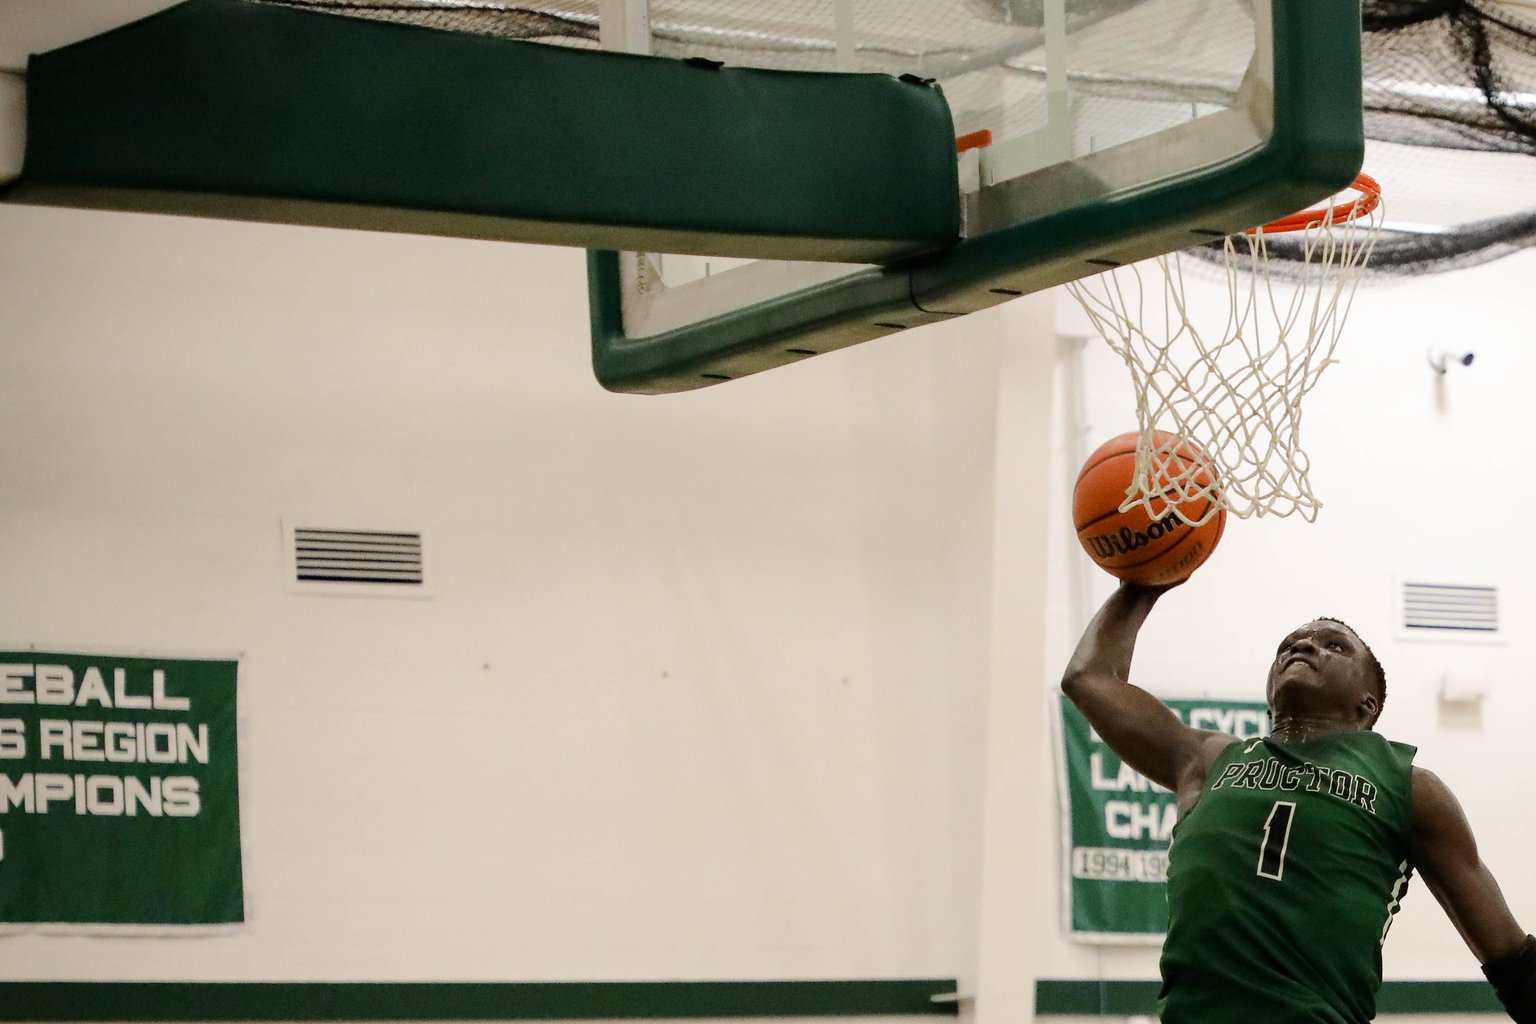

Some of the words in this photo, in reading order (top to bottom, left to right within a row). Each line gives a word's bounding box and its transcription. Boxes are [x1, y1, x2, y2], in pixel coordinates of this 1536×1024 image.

[1089, 510, 1185, 559] Wilson
[0, 663, 190, 711] EBALL
[40, 719, 209, 764] REGION
[1210, 757, 1379, 815] PROCTOR
[1081, 853, 1131, 876] 1994
[1256, 801, 1297, 882] 1
